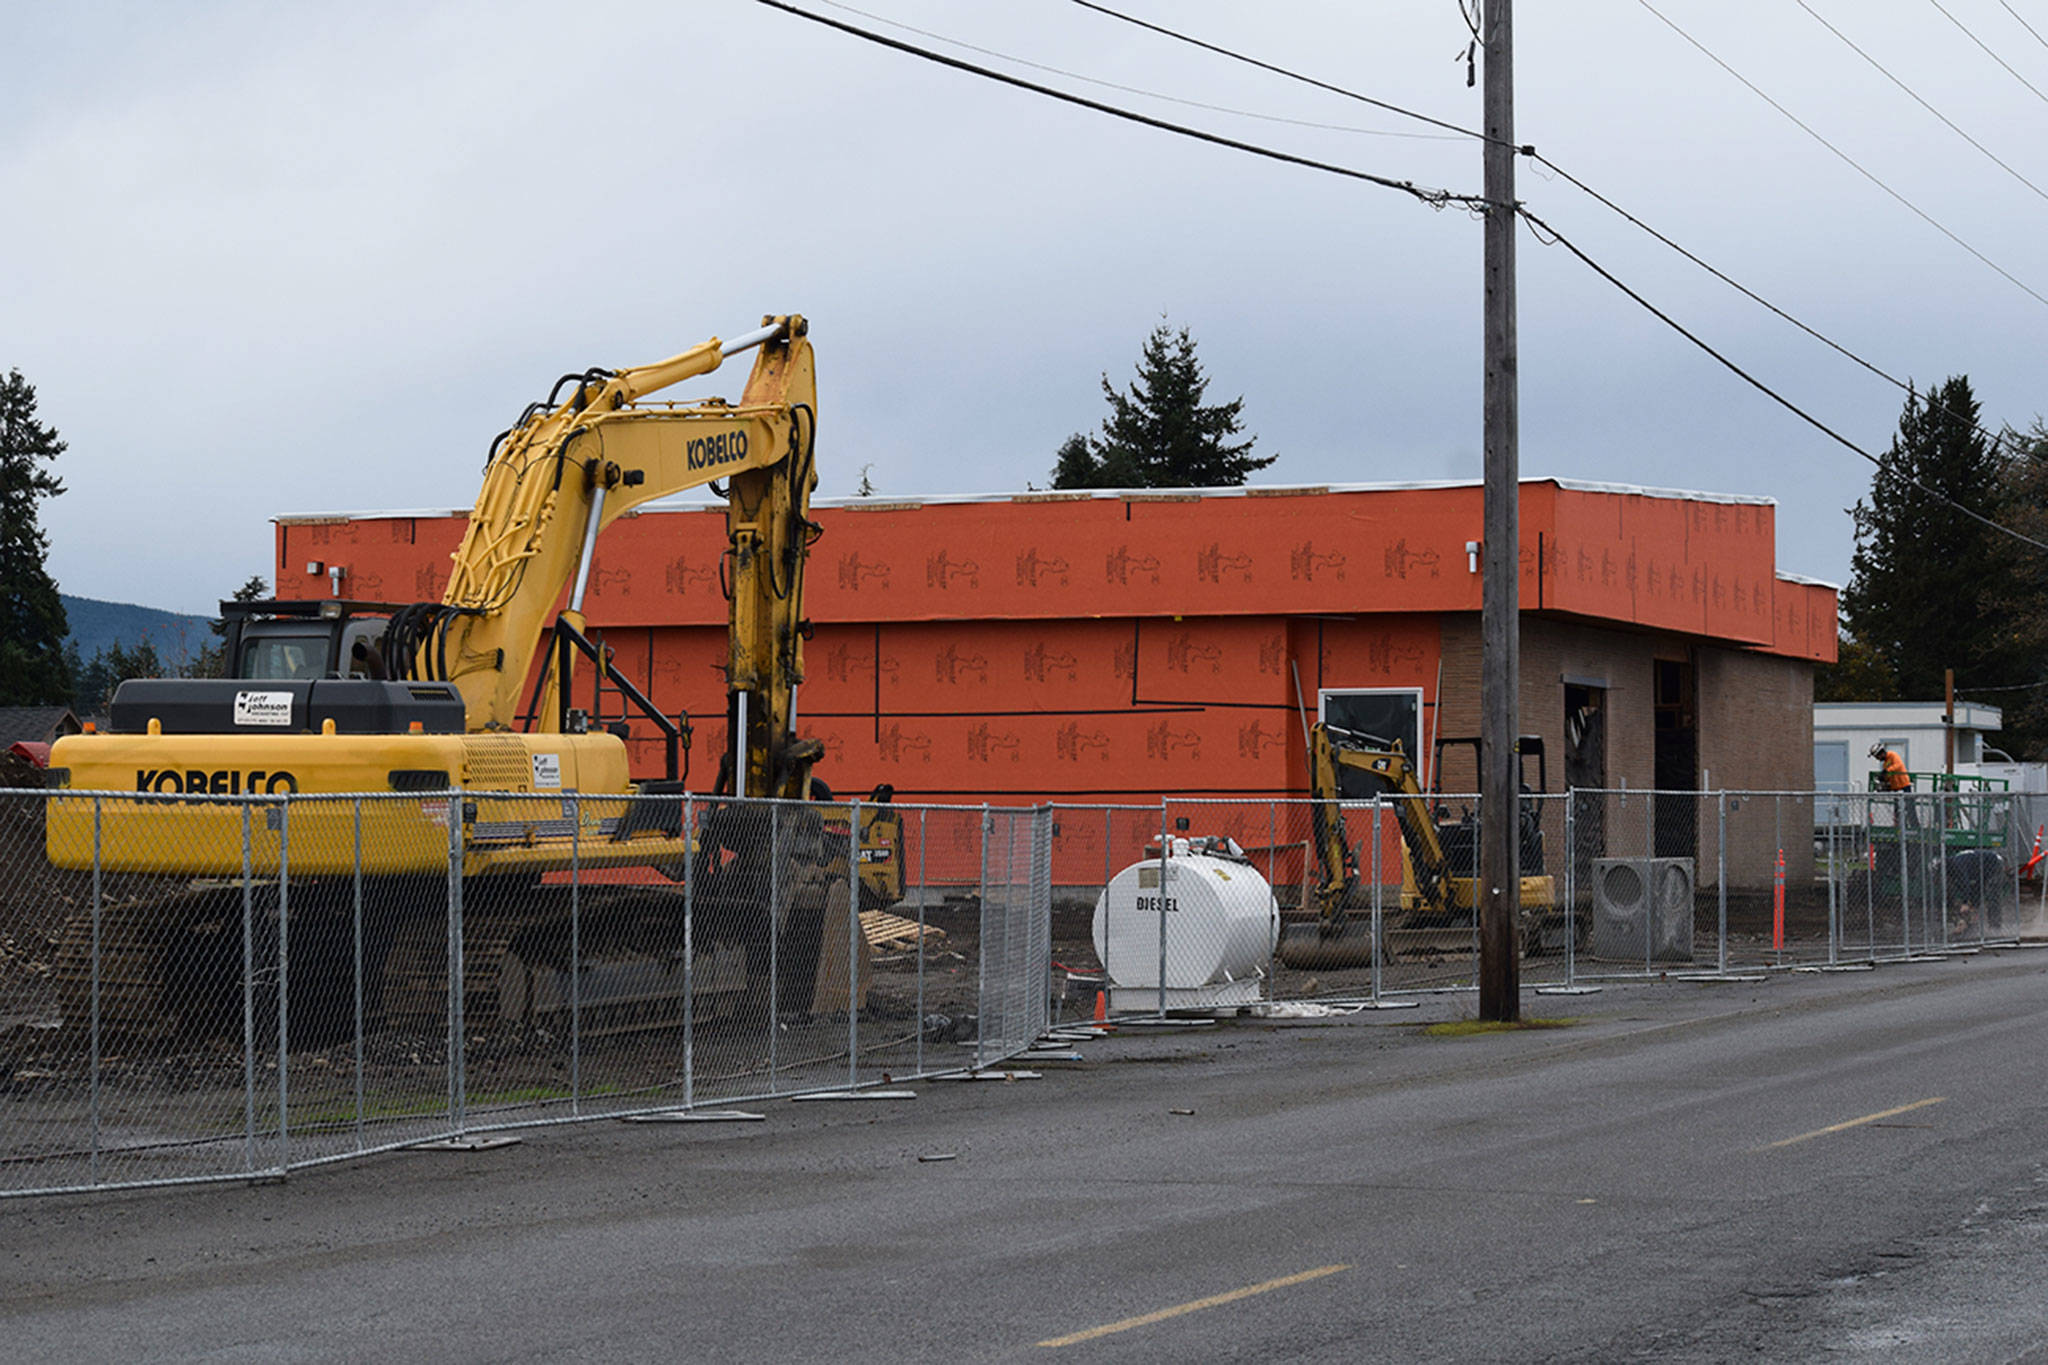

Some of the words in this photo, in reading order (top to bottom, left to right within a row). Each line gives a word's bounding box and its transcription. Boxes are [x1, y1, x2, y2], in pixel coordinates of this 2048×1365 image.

[687, 430, 748, 471] KOBELCO
[134, 770, 298, 806] KOBELCO
[1136, 897, 1179, 912] DIESEL
